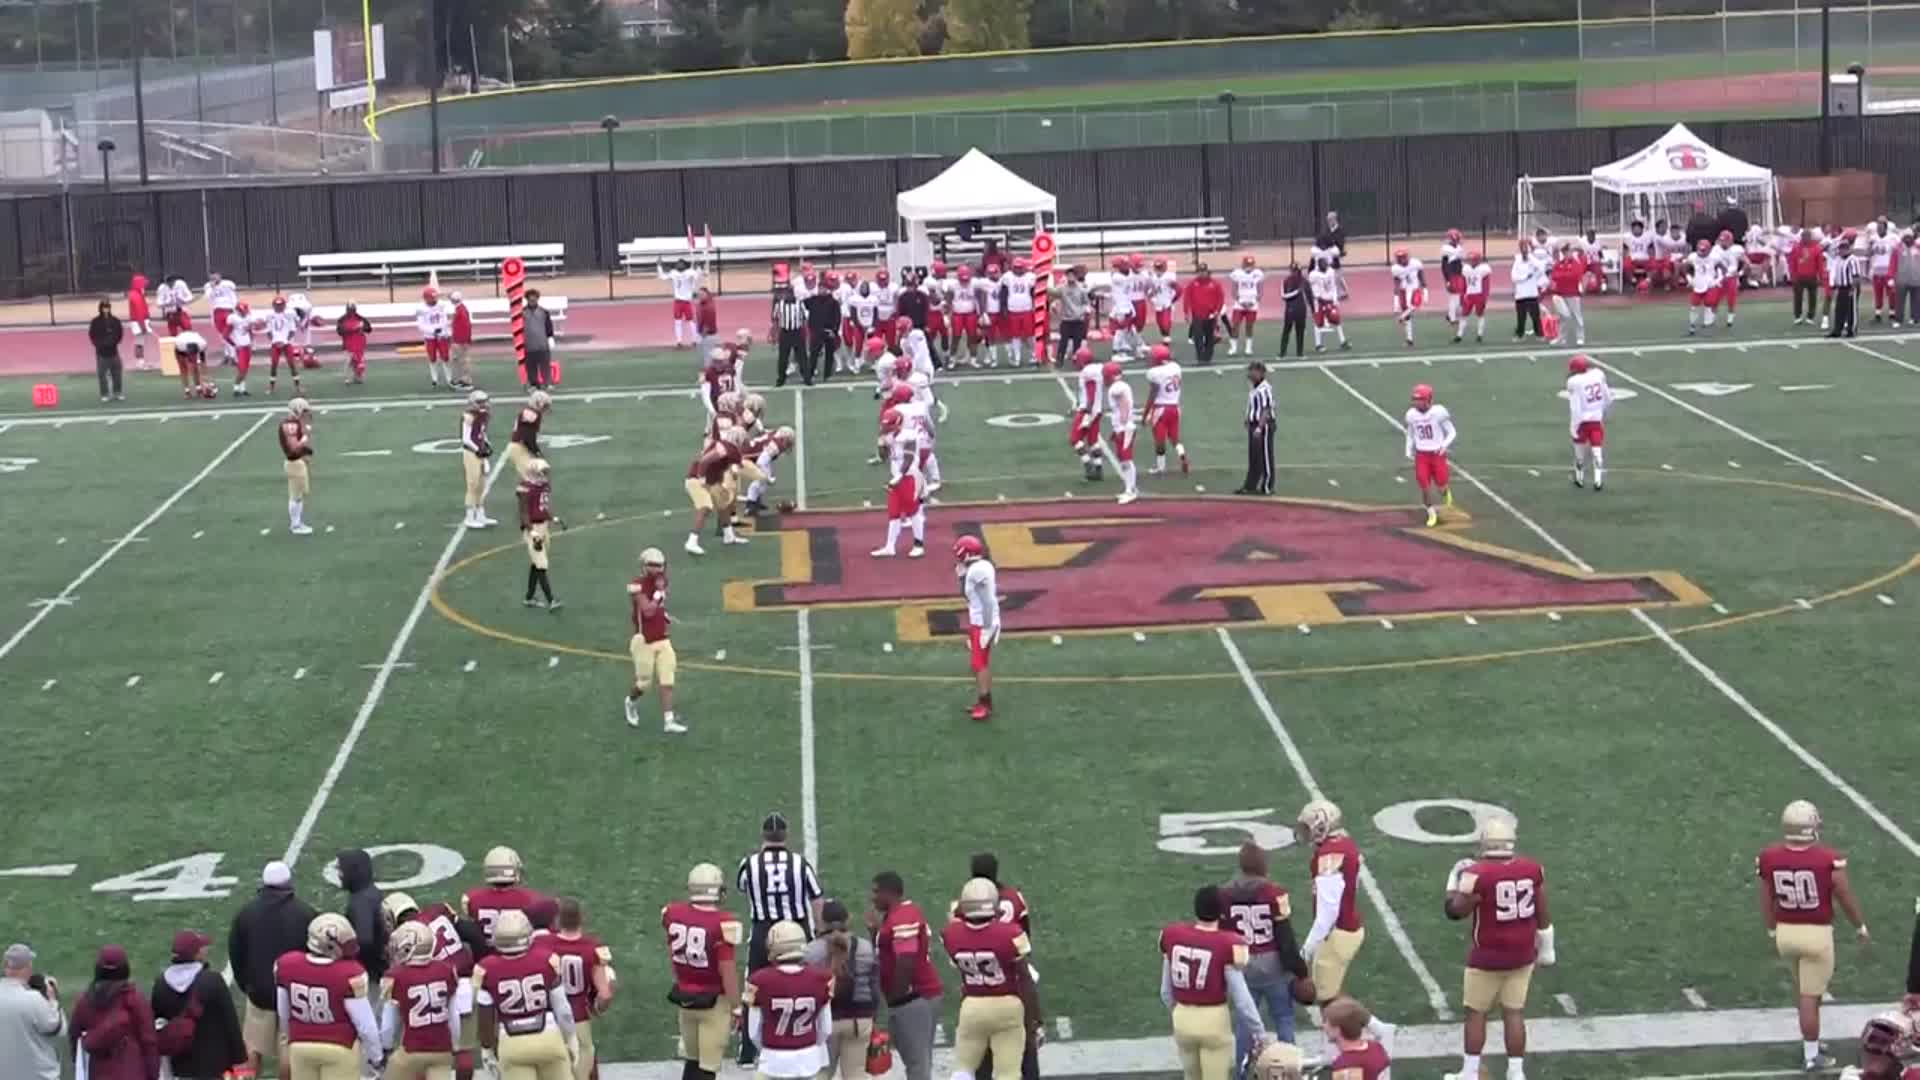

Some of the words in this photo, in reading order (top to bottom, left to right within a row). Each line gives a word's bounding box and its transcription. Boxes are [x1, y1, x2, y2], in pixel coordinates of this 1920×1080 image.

[1584, 383, 1603, 403] 32
[1417, 424, 1433, 440] 30
[764, 863, 788, 893] H
[1773, 870, 1820, 909] 50
[1495, 878, 1535, 921] 92
[1230, 904, 1274, 945] 35
[669, 923, 708, 968] 28
[560, 954, 585, 995] 0
[954, 952, 1006, 986] 93
[1170, 945, 1212, 990] 67
[290, 982, 335, 1024] 58
[407, 981, 449, 1027] 25
[498, 974, 548, 1014] 26
[771, 996, 816, 1036] 72
